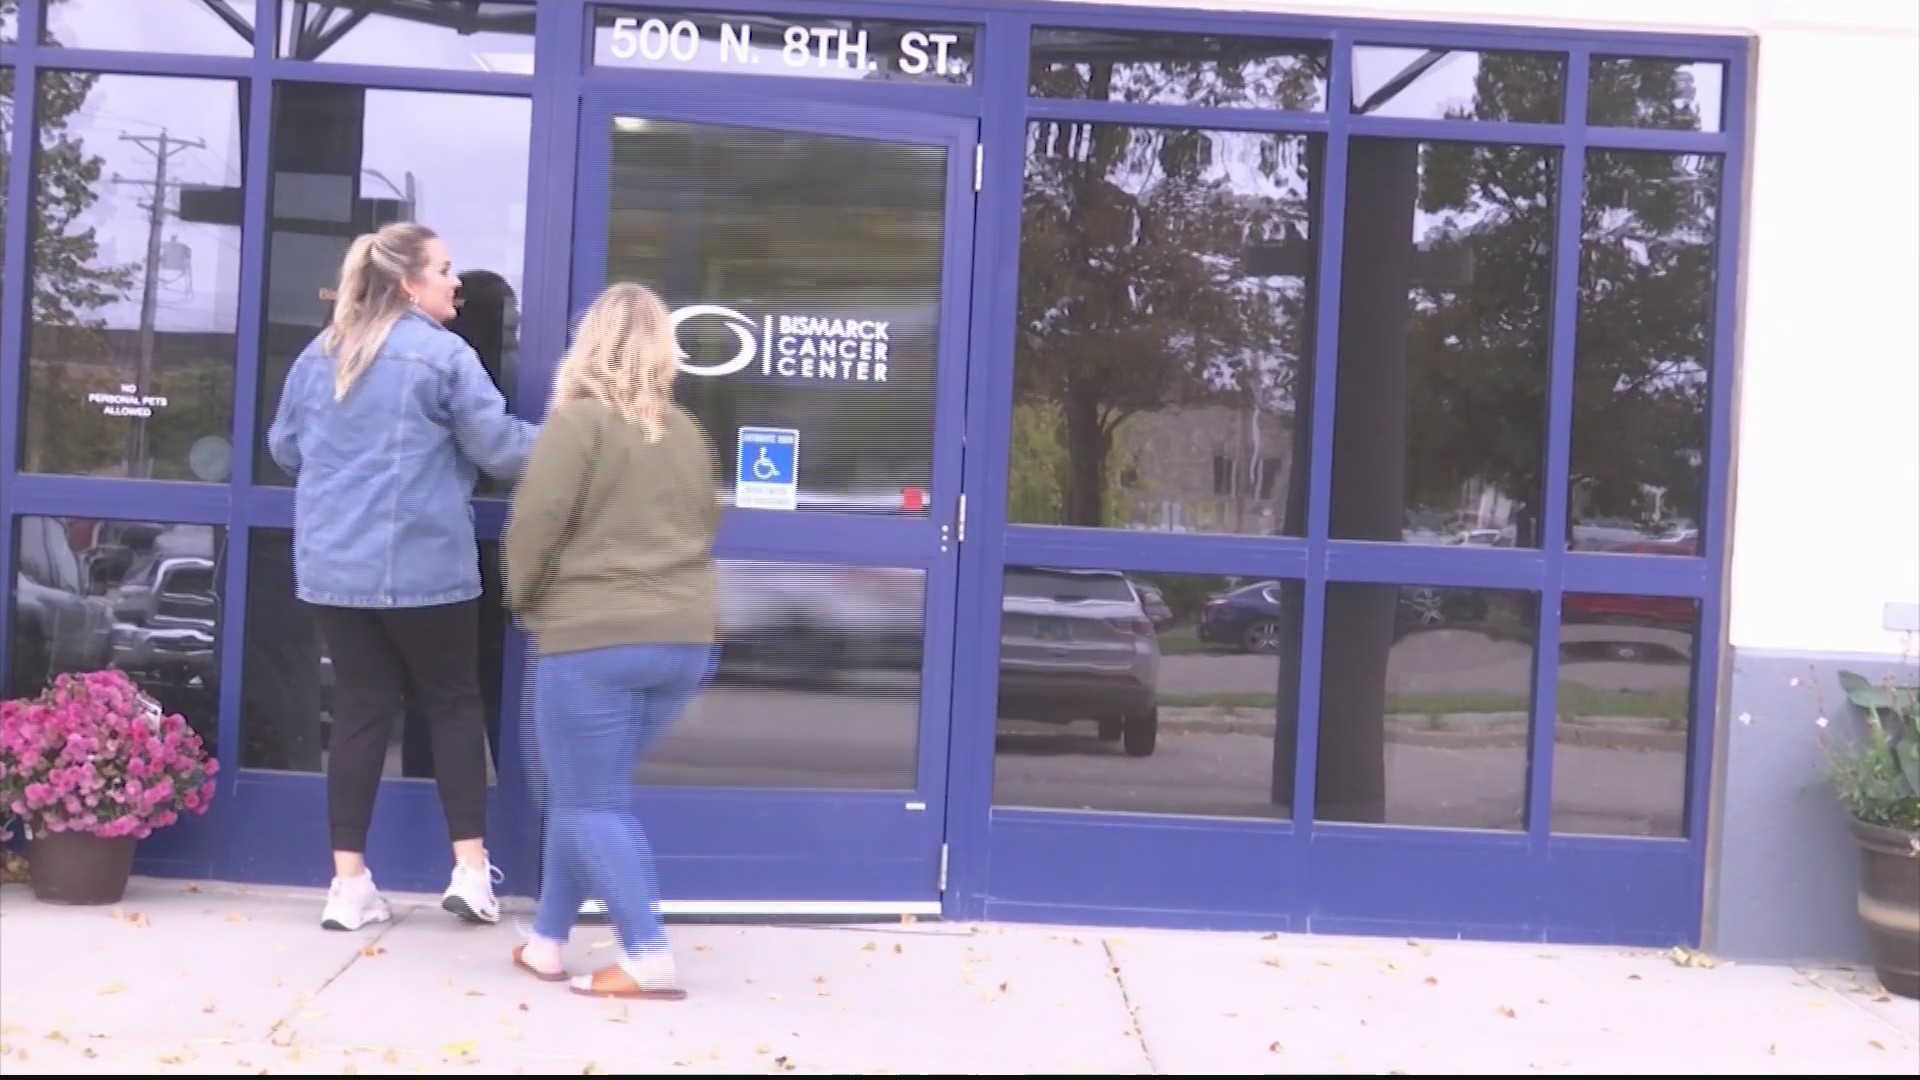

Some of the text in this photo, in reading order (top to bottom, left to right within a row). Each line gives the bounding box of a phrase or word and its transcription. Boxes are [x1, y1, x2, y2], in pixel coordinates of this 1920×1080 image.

[610, 17, 962, 76] 500 N. 8TH. ST.
[778, 314, 890, 341] BISMARCK
[777, 336, 889, 361] CANCER
[777, 357, 888, 382] CENTER
[88, 393, 168, 407] PERSONAL PETS
[120, 383, 137, 394] NO
[103, 406, 152, 418] ALLOWED
